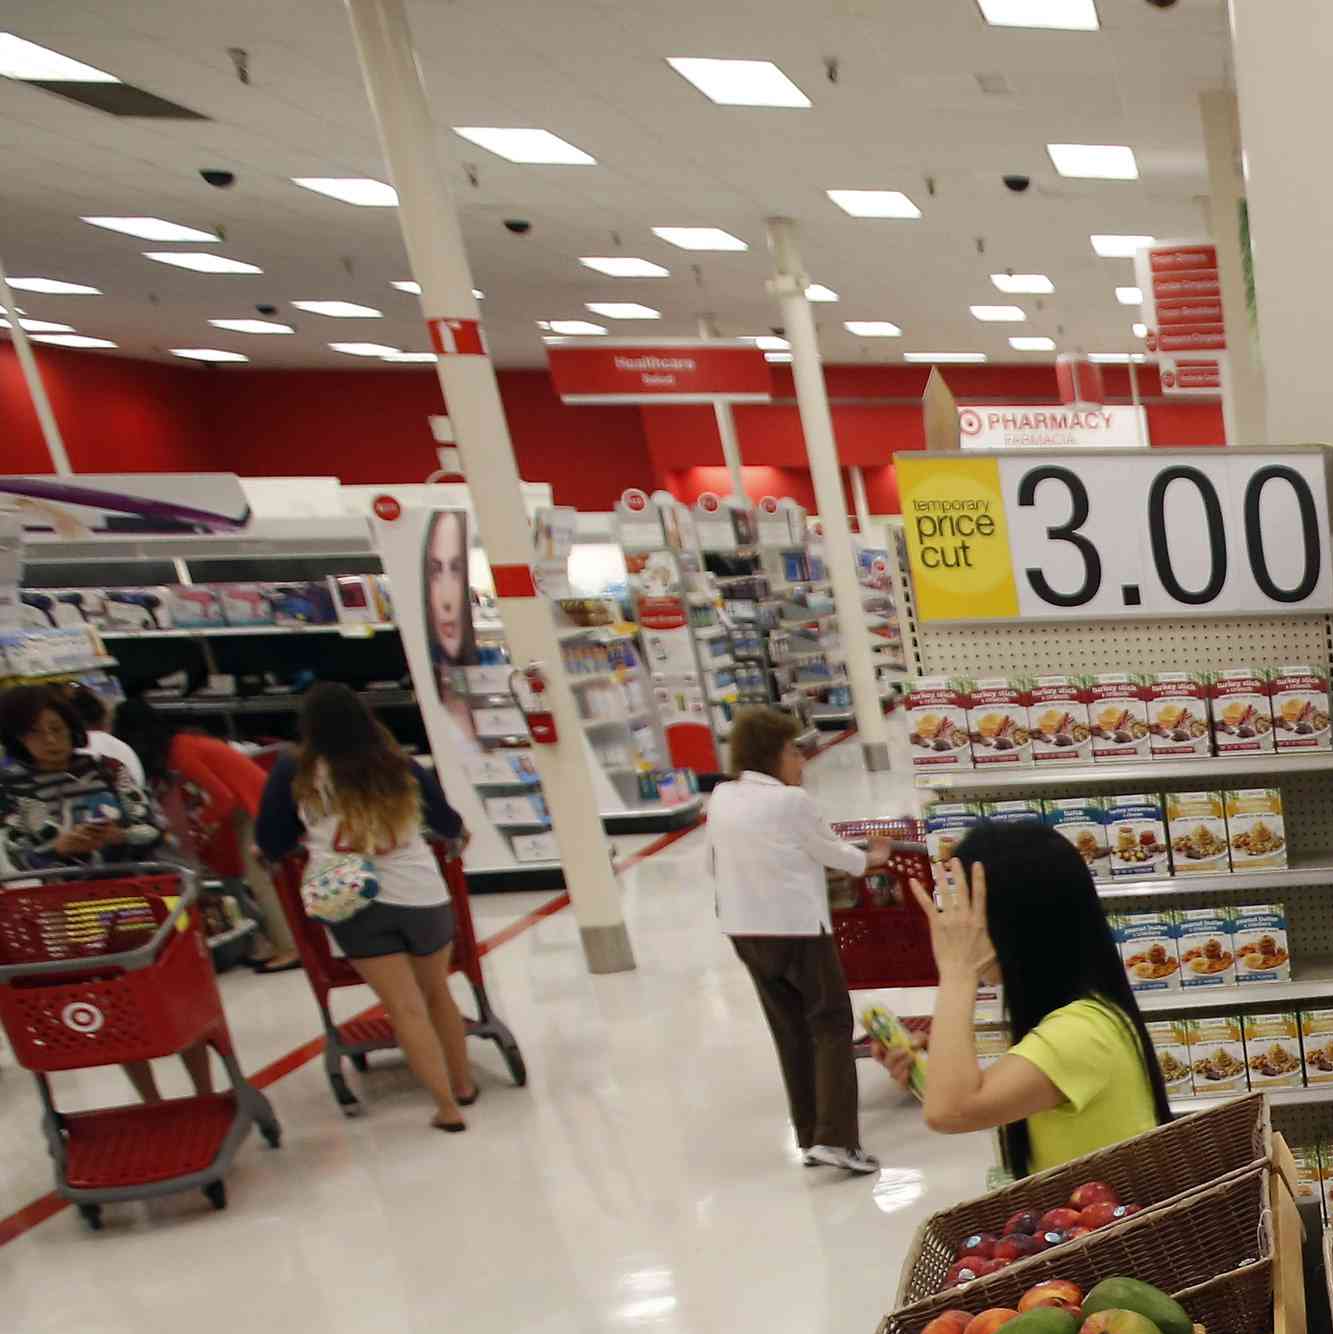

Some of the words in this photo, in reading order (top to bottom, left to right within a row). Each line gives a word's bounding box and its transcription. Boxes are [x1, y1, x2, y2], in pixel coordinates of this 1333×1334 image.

[987, 412, 1112, 430] PHARMACY
[912, 498, 991, 514] temporary
[916, 510, 995, 545] price
[1017, 463, 1321, 608] 3.00
[921, 540, 974, 569] cut
